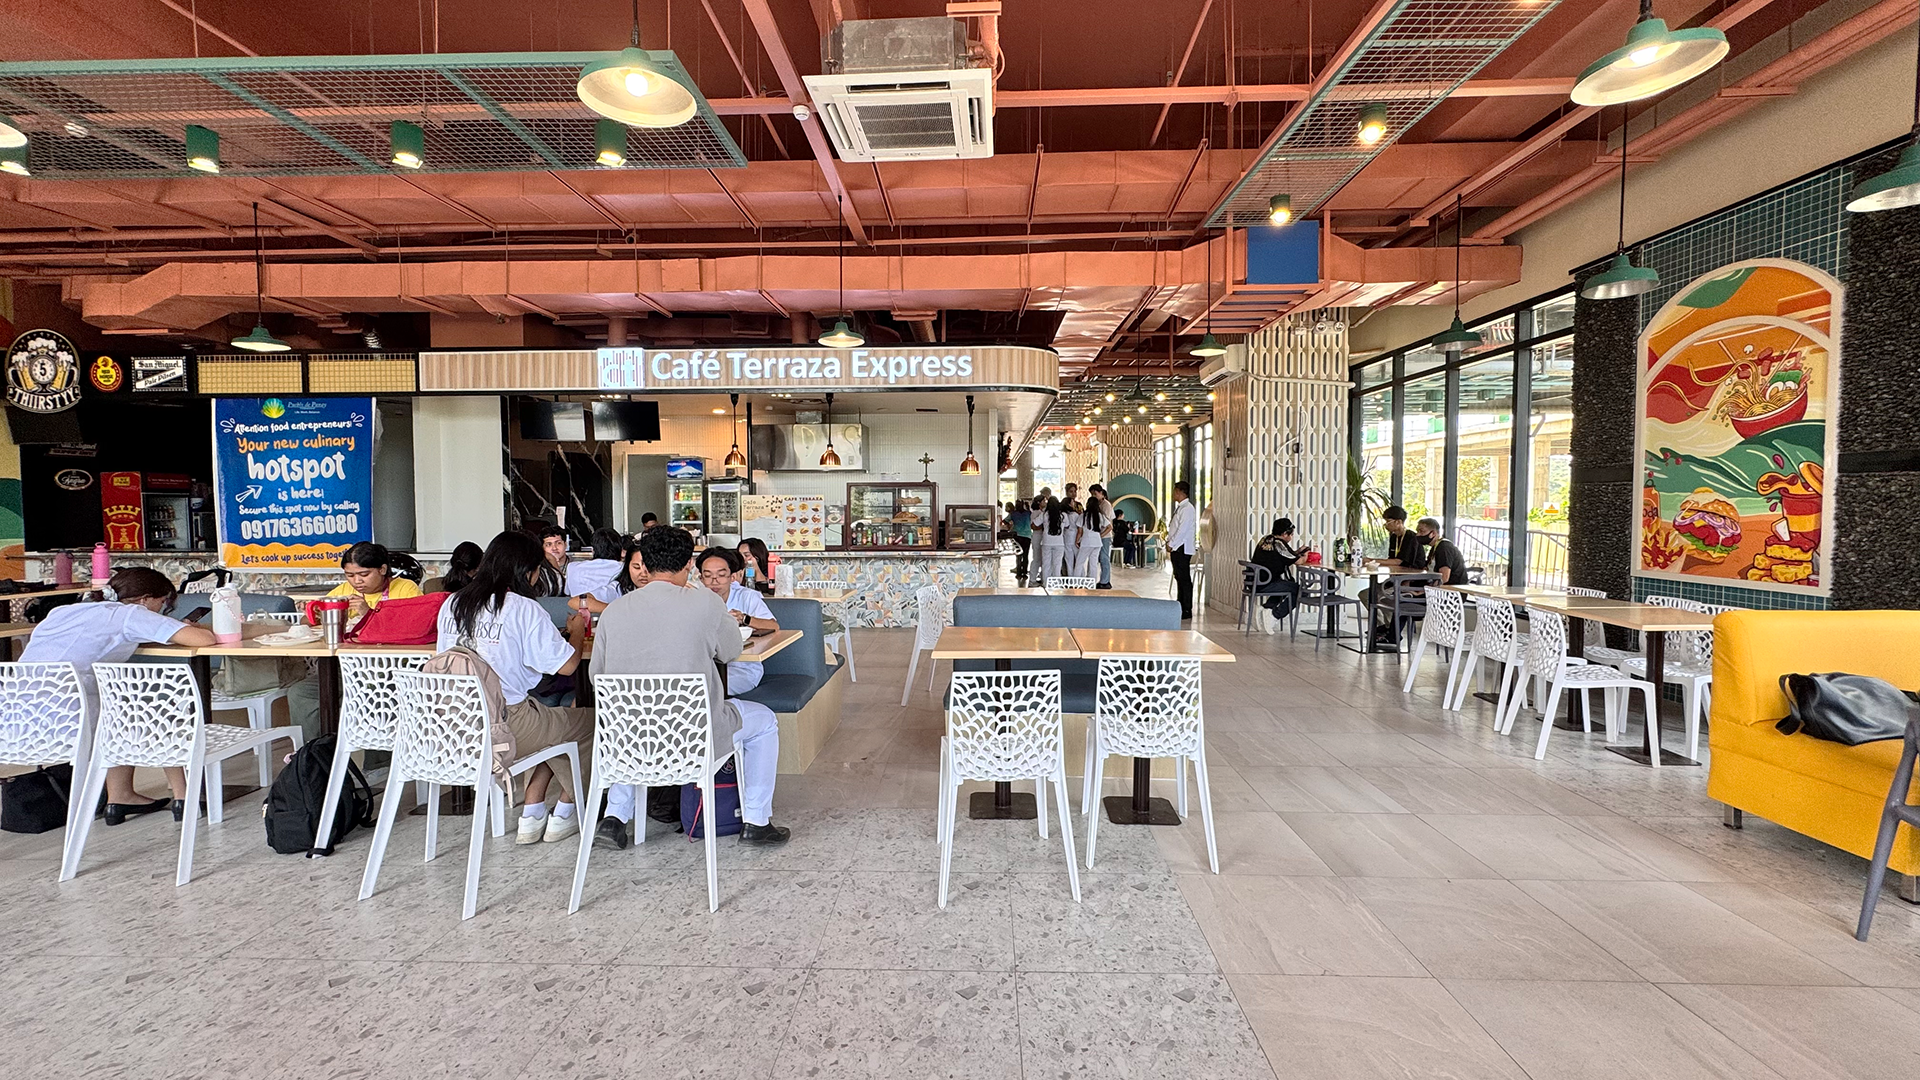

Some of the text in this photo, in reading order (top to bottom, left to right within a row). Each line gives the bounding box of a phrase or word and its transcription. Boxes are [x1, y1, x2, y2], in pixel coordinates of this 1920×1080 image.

[40, 363, 47, 377] 5
[652, 350, 973, 383] Café Terraza Express
[144, 378, 157, 387] Pale
[157, 371, 177, 382] Pilsen
[14, 387, 75, 410] THIIRSTYY
[234, 423, 269, 435] Attention
[270, 421, 289, 434] food
[236, 433, 355, 454] Your new culinary
[247, 451, 346, 489] hotspot
[277, 488, 288, 500] is
[239, 500, 360, 515] Secure this spot now by calling
[240, 513, 358, 540] 09176366080
[261, 552, 279, 562] cook
[281, 552, 291, 564] up
[293, 550, 324, 561] success
